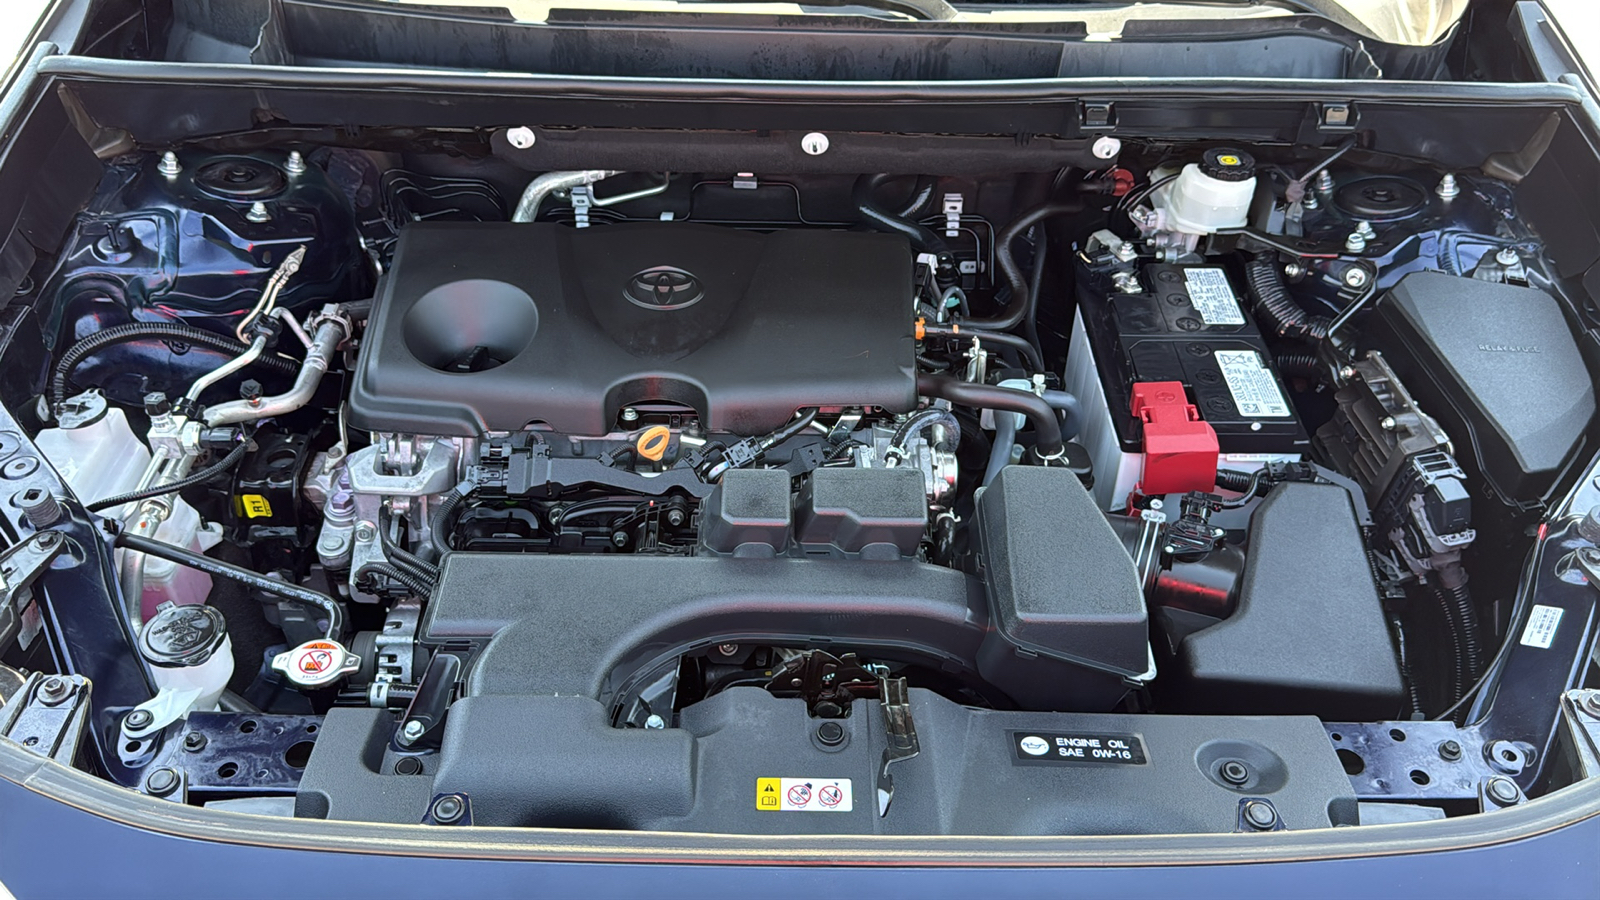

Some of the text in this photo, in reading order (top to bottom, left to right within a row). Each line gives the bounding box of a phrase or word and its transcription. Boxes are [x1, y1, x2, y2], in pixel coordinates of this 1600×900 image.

[1478, 344, 1506, 352] RELAY
[250, 500, 264, 513] R1
[1055, 738, 1129, 749] ENGINE OIL
[1058, 747, 1132, 760] SAE 0W-16
